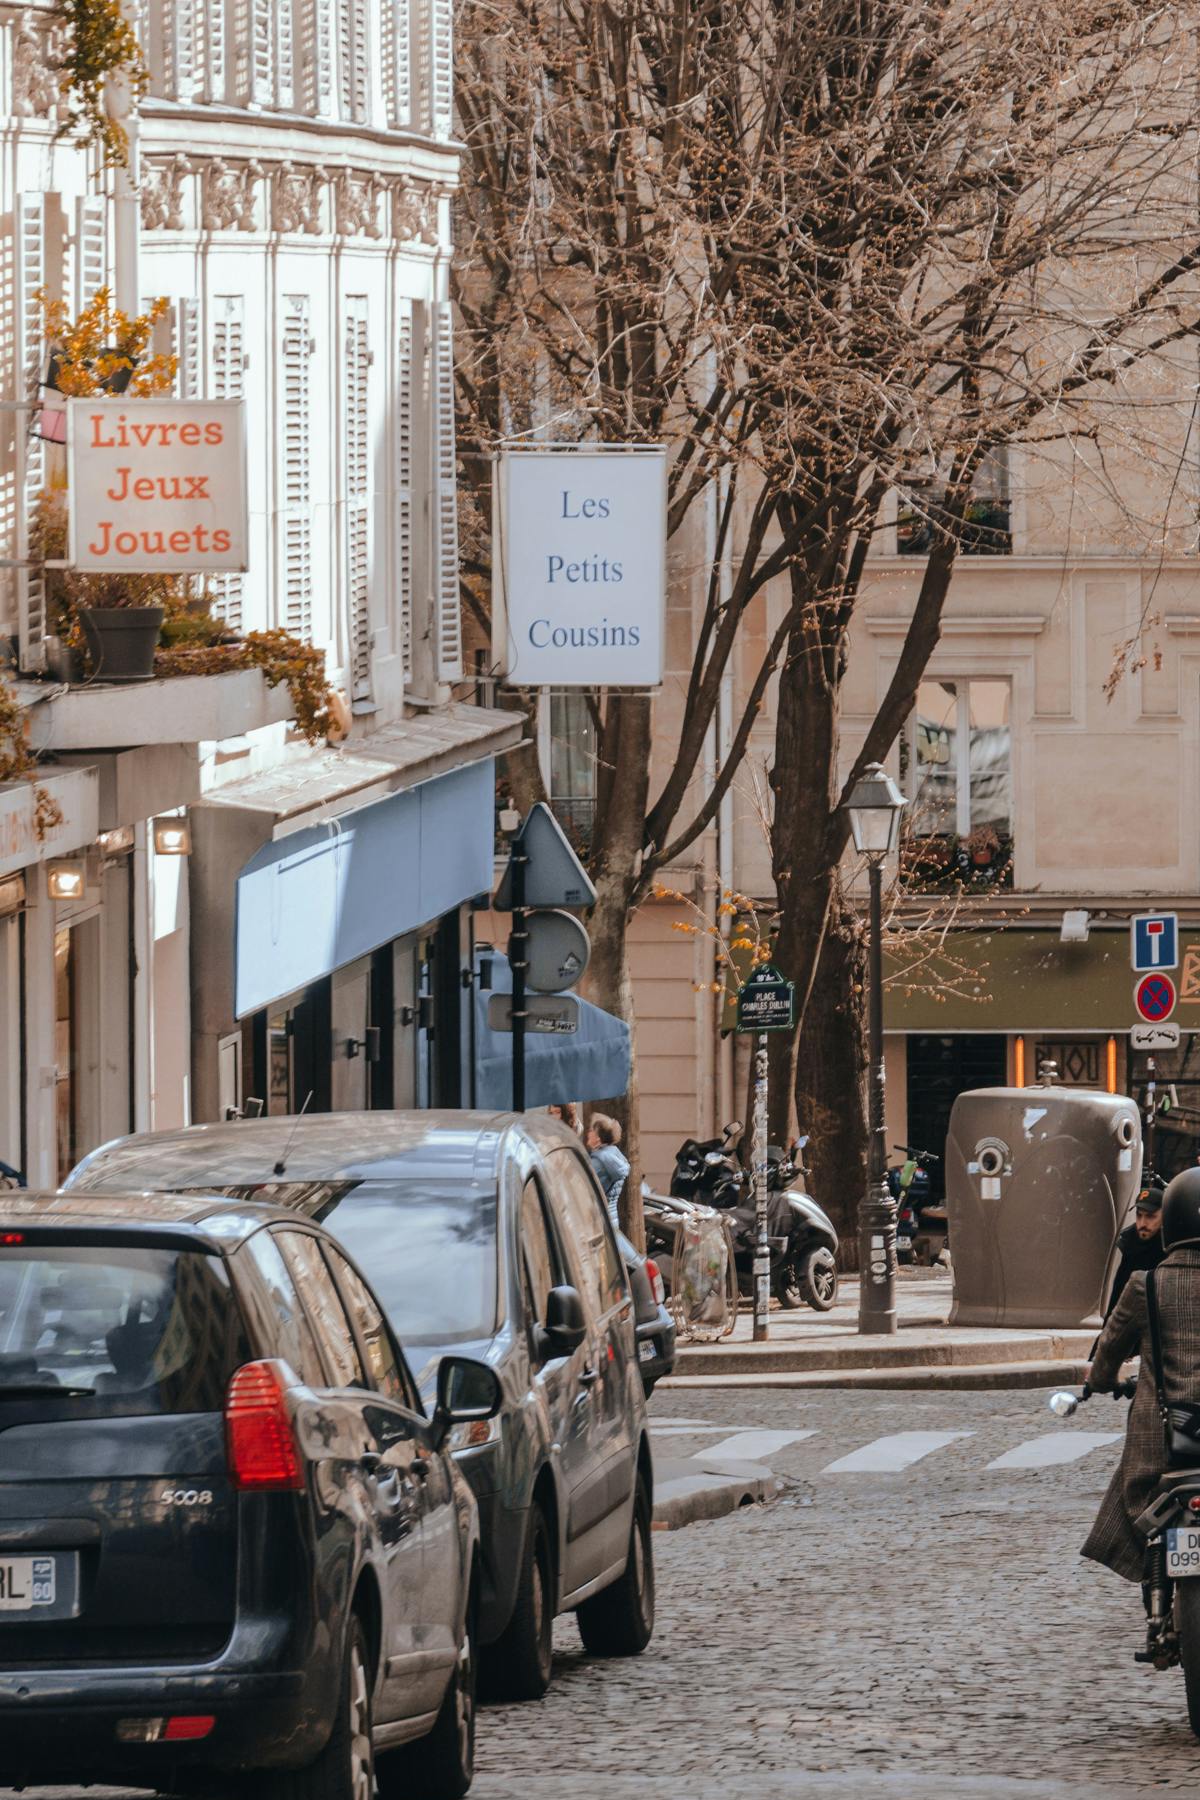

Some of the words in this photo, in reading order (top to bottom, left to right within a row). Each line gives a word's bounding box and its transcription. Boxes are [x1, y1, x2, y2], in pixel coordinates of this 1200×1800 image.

[90, 414, 223, 448] Livres
[107, 467, 210, 501] Jeux
[561, 491, 611, 518] Les
[88, 522, 231, 556] Jouets
[546, 553, 624, 583] Petits
[528, 618, 641, 649] Cousins
[742, 1001, 768, 1012] CHARLES
[755, 992, 776, 1001] PLACE
[160, 1489, 214, 1506] 5008
[0, 1566, 25, 1599] L
[33, 1581, 50, 1600] 60
